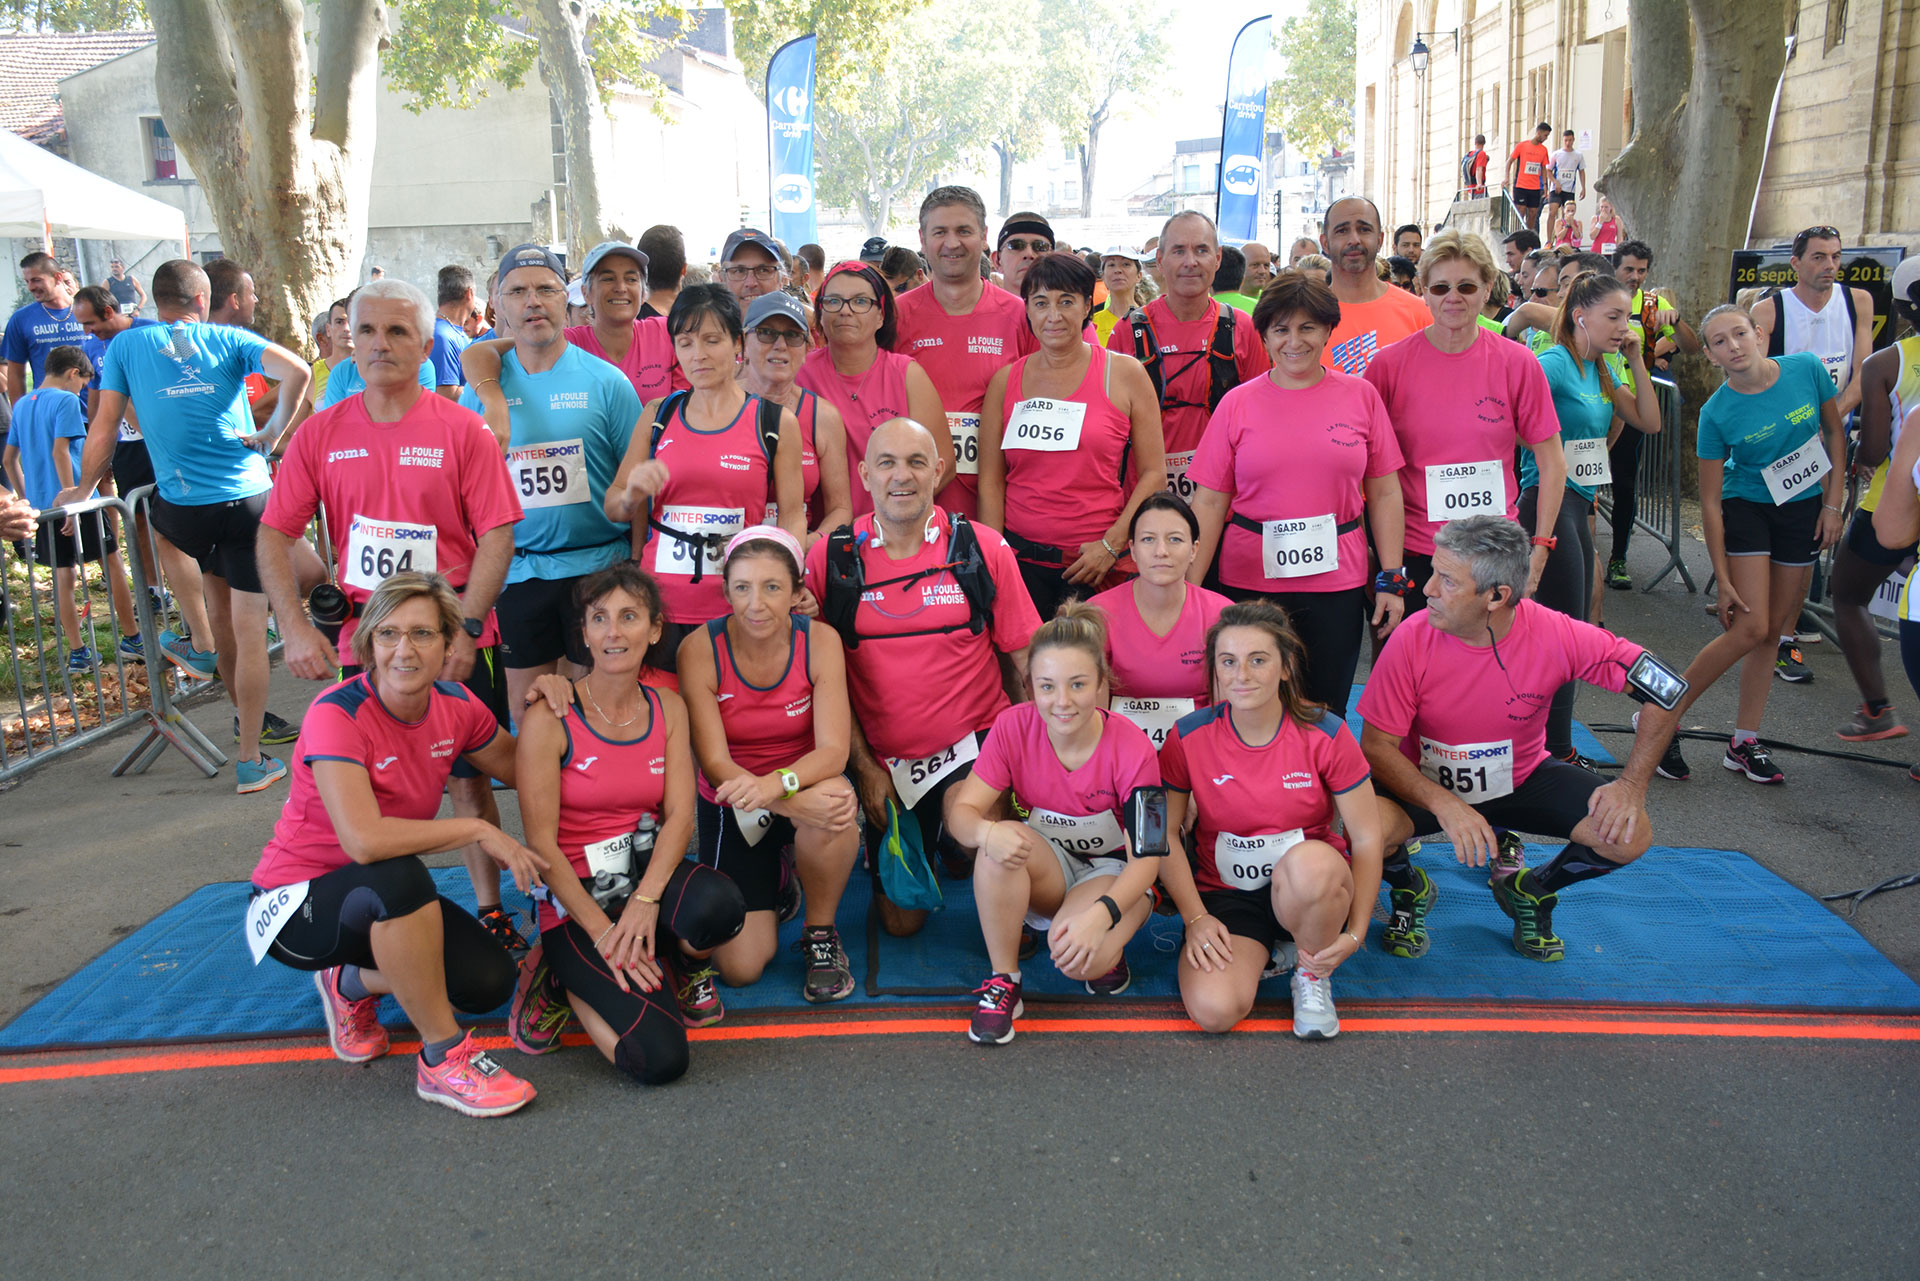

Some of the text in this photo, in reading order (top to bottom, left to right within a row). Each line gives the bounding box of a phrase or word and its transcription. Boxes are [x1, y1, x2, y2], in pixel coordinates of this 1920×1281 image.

[1228, 100, 1264, 113] Carrefou
[1736, 266, 1893, 285] 26 septee 2015
[33, 323, 59, 335] GALUY
[968, 336, 1003, 347] LA FOULEE
[968, 345, 1002, 355] MEYNOISE
[1331, 330, 1377, 367] RUN
[166, 385, 215, 396] Tarahumara
[549, 392, 589, 402] LA FOULEE
[550, 401, 588, 410] MEYNOISE
[1026, 401, 1053, 411] GARD
[1784, 403, 1810, 420] LIBERTY
[1791, 407, 1815, 426] SPORT
[1018, 424, 1065, 441] 0056
[1579, 441, 1595, 450] GARD
[400, 447, 444, 458] LA FOULEE
[512, 444, 580, 462] INTERSPORT
[729, 454, 751, 463] FOULEE
[399, 457, 442, 468] MEYNOISE
[1776, 452, 1801, 469] GARD
[1446, 466, 1476, 477] GARD
[1575, 462, 1603, 477] 0036
[1782, 461, 1819, 490] 0046
[520, 465, 568, 498] 559
[1445, 491, 1492, 509] 0058
[671, 512, 741, 524] INTERSPORT
[360, 524, 433, 540] INTERSPORT
[1278, 522, 1306, 533] GARD
[361, 545, 415, 579] 664
[1277, 546, 1324, 566] 0068
[921, 586, 932, 596] LA
[923, 594, 965, 606] MEYNOISE
[1129, 701, 1160, 711] GARD
[1505, 698, 1515, 706] LA
[1432, 745, 1510, 761] INTERSPORT
[911, 745, 957, 785] 564
[1438, 765, 1488, 794] 851
[1046, 814, 1077, 827] GARD
[1232, 838, 1265, 849] GARD
[1233, 863, 1273, 880] 006
[256, 888, 290, 937] 0066
